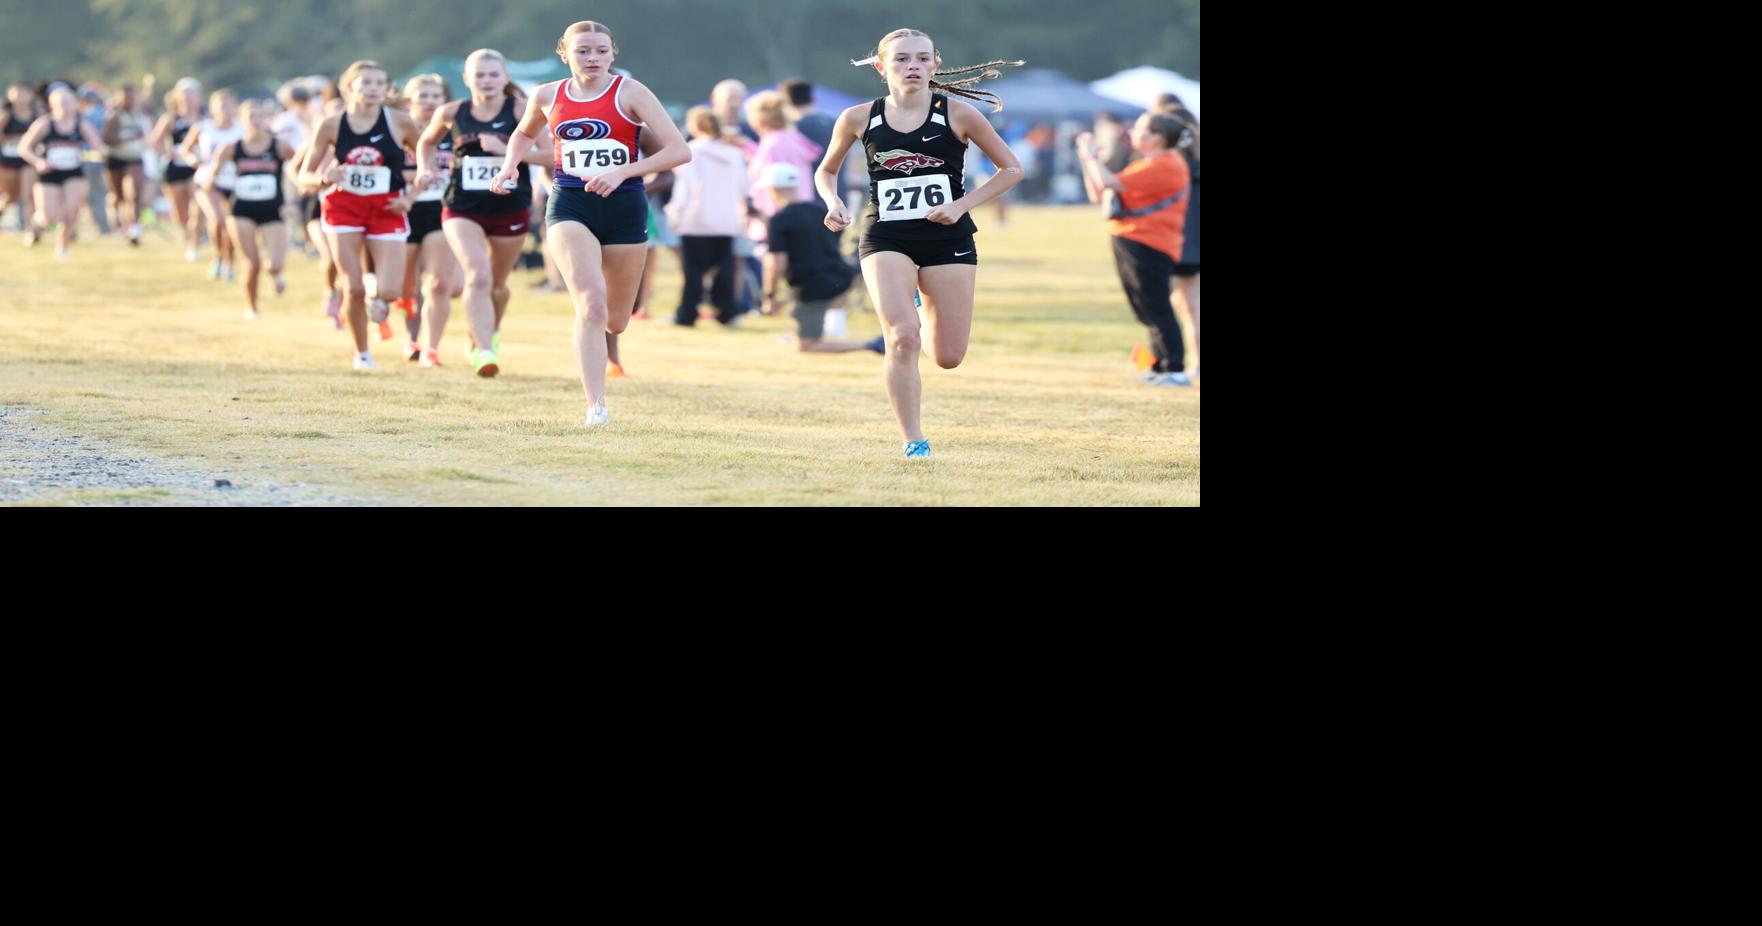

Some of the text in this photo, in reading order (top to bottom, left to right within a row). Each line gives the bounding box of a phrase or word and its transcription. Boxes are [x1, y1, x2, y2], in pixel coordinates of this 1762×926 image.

[564, 148, 627, 168] 1759
[350, 173, 376, 189] 85
[884, 184, 945, 211] 276
